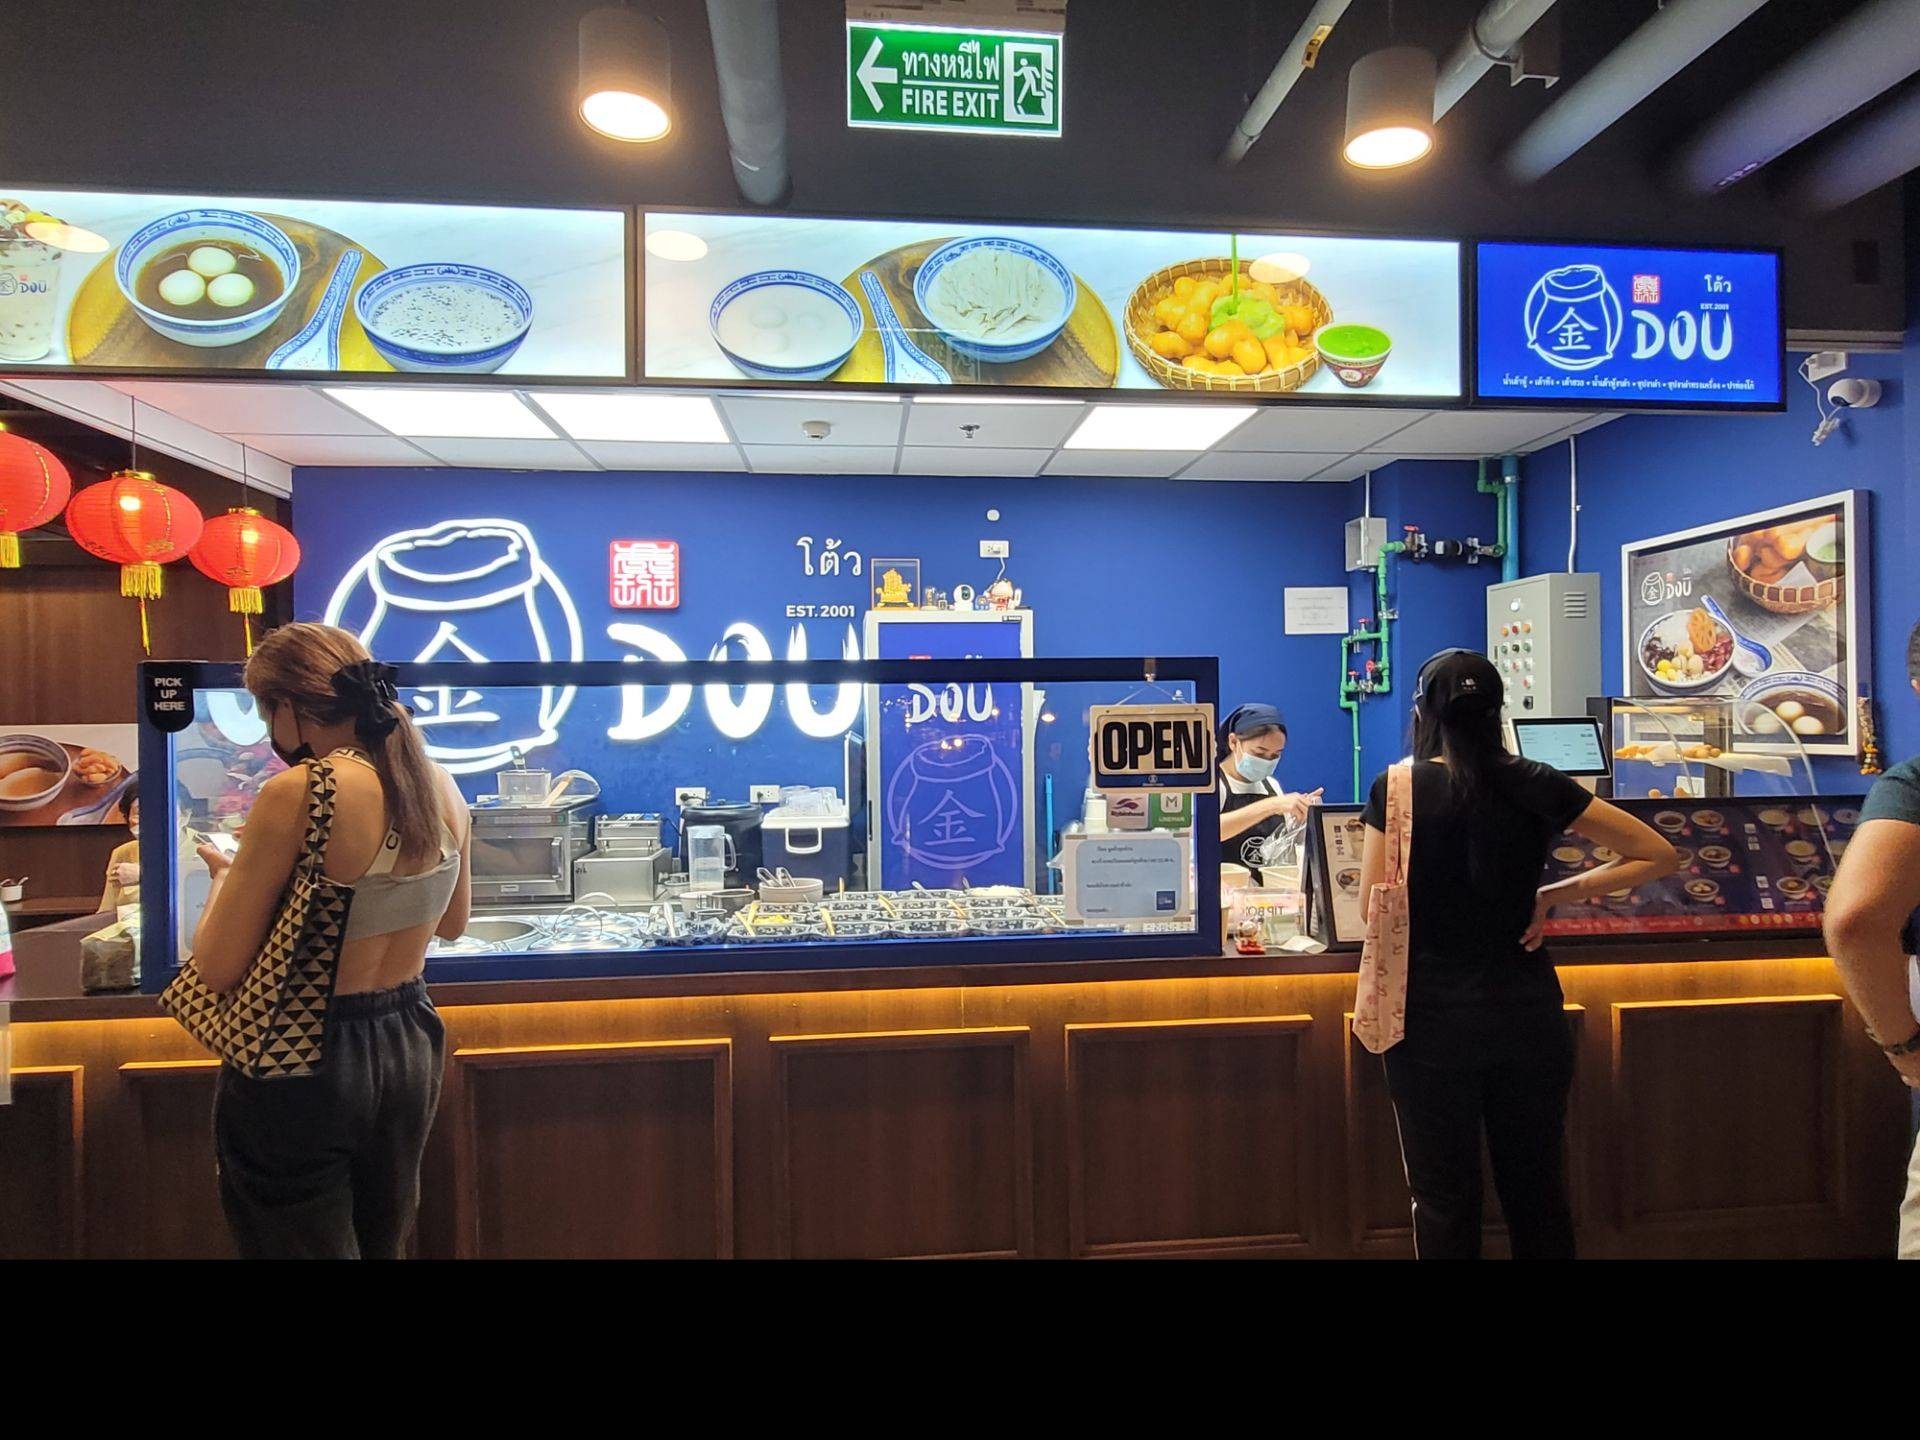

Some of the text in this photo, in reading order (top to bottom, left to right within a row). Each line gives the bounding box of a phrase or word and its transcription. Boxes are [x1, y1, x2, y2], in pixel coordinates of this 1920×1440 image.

[902, 40, 1000, 81] ทางหนีไฟ
[902, 88, 1000, 119] FIRE EXIT
[1546, 306, 1600, 351] 金
[1631, 309, 1733, 361] DOU
[796, 536, 862, 576] โต้ว
[785, 605, 856, 618] EST. 2001
[153, 677, 183, 687] PICK
[160, 690, 177, 699] UP
[606, 620, 863, 741] DOU
[153, 701, 186, 711] HERE
[907, 682, 993, 724] DOU
[1102, 721, 1203, 770] OPEN
[917, 788, 987, 847] 金
